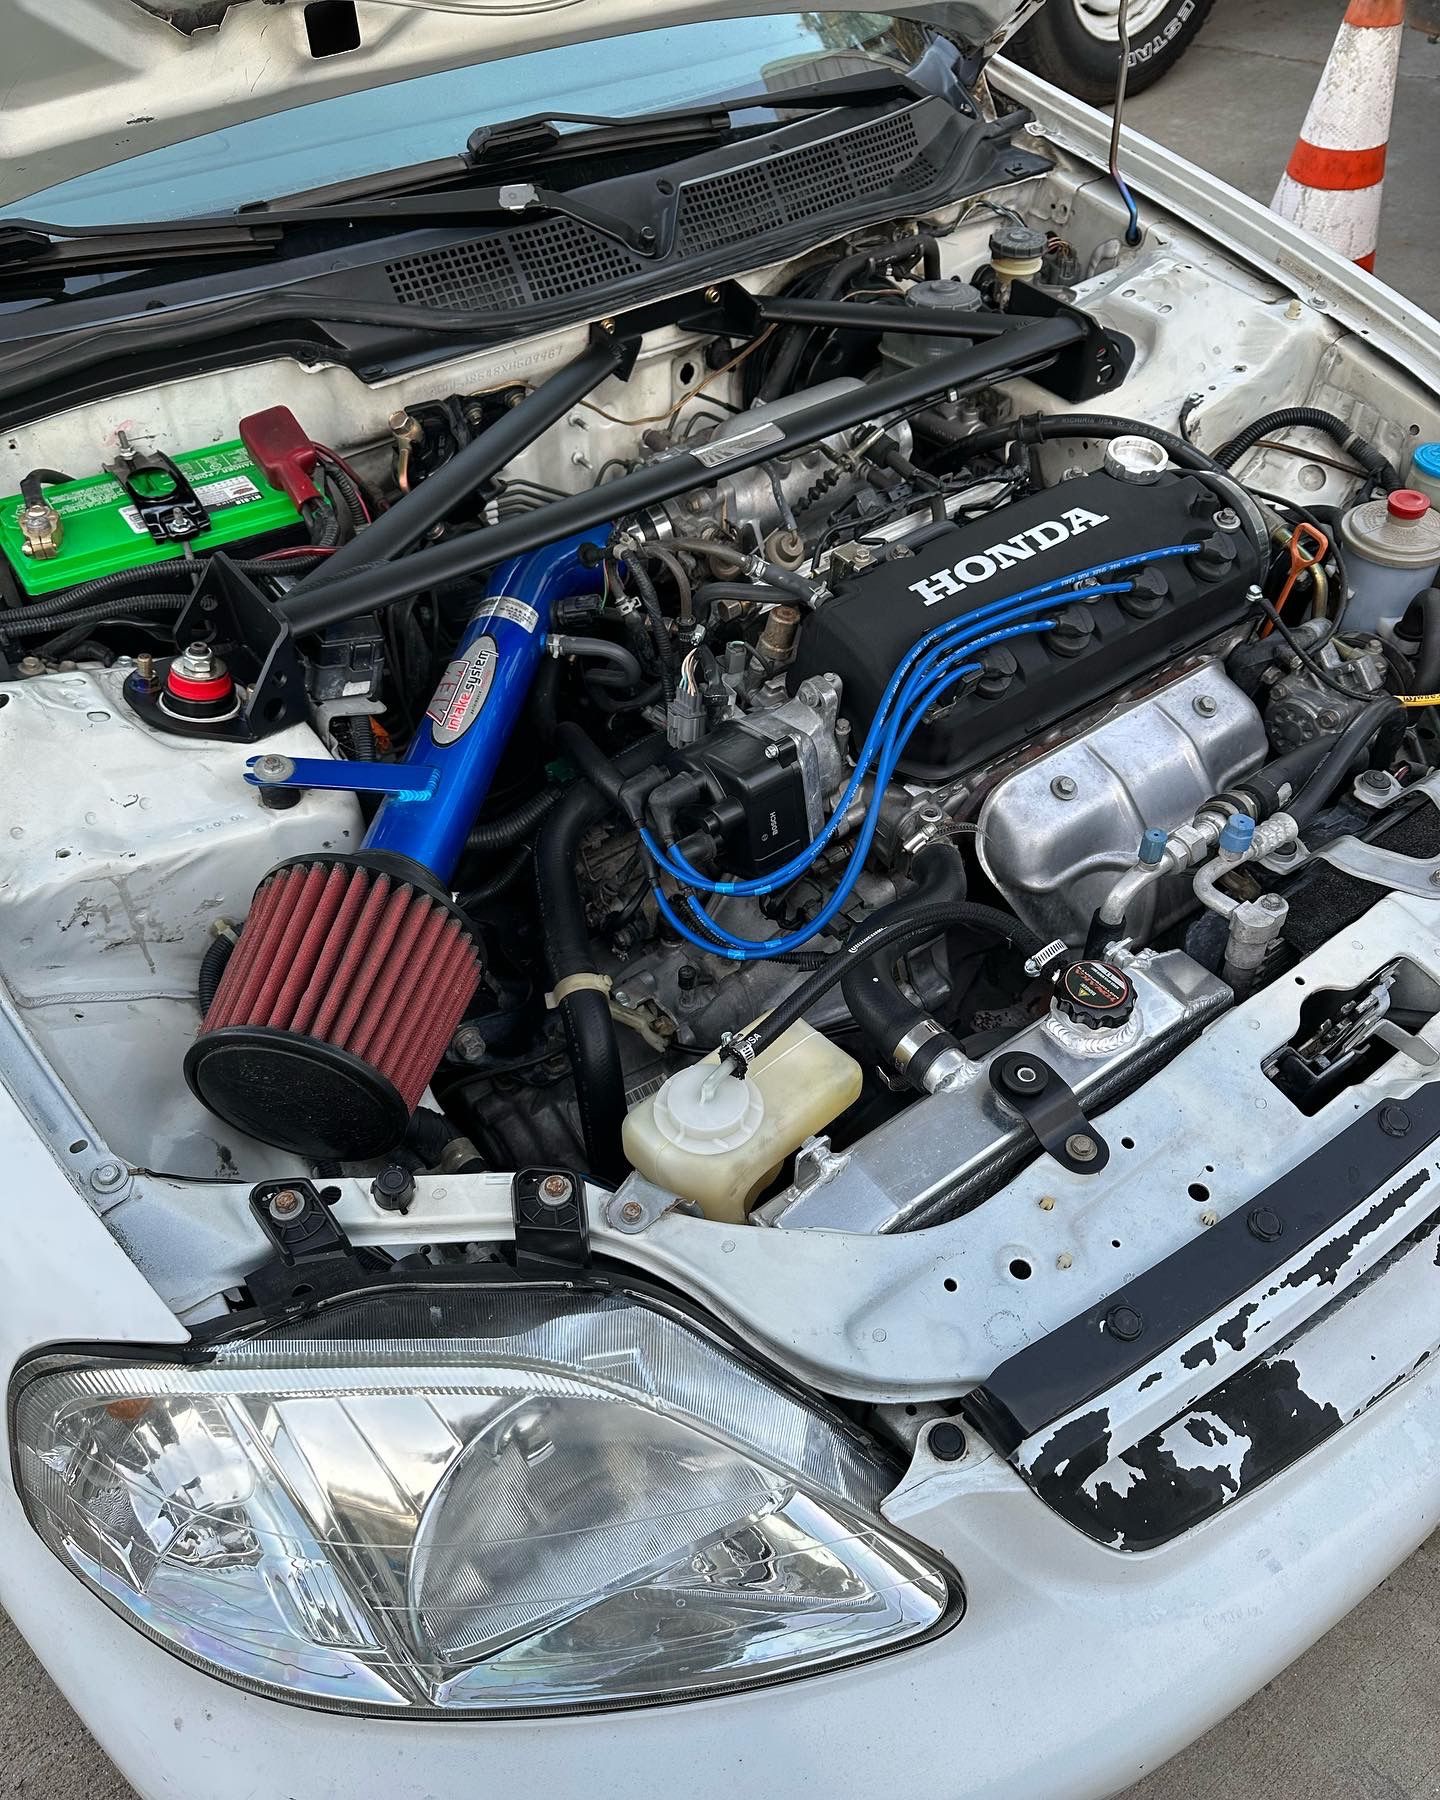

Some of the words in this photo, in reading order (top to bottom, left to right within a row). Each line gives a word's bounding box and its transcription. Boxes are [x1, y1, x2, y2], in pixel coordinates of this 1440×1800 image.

[908, 507, 1110, 607] HONDA
[447, 690, 472, 732] intake
[464, 648, 499, 692] system
[769, 811, 777, 836] BOSCH
